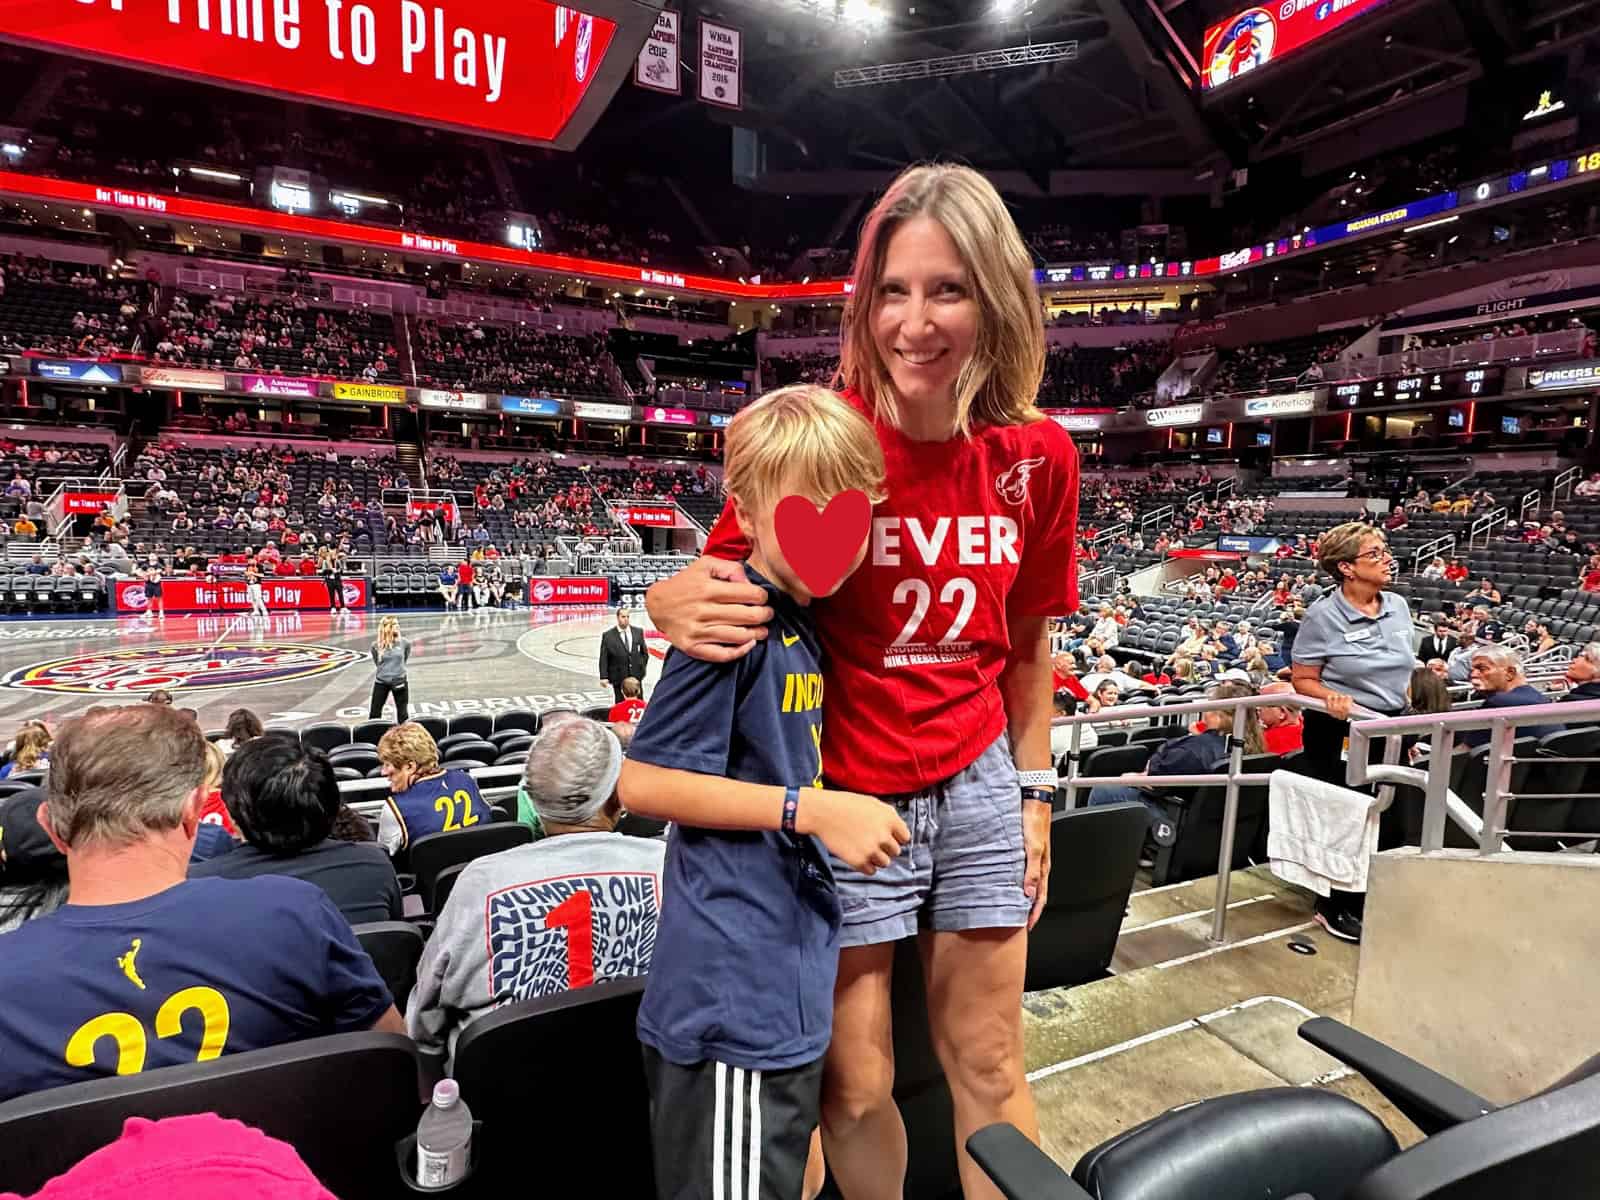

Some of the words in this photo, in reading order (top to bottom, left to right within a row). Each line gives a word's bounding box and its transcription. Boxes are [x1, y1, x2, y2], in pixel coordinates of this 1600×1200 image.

[709, 30, 732, 45] WNBA
[167, 0, 300, 49] me
[325, 0, 376, 65] to
[401, 0, 506, 102] Play
[648, 44, 667, 58] 2012
[1476, 298, 1526, 315] FLIGHT
[1545, 367, 1593, 381] PACERS
[350, 387, 404, 400] GAINBRIDGE
[1271, 399, 1312, 409] Kinetico
[873, 515, 1020, 567] EVER
[195, 587, 217, 604] Her
[274, 586, 301, 606] Play
[890, 577, 978, 647] 22
[883, 655, 909, 669] NIKE
[909, 653, 940, 665] REBEL
[434, 789, 479, 832] 22
[609, 876, 654, 908] ONE
[546, 889, 594, 990] 1
